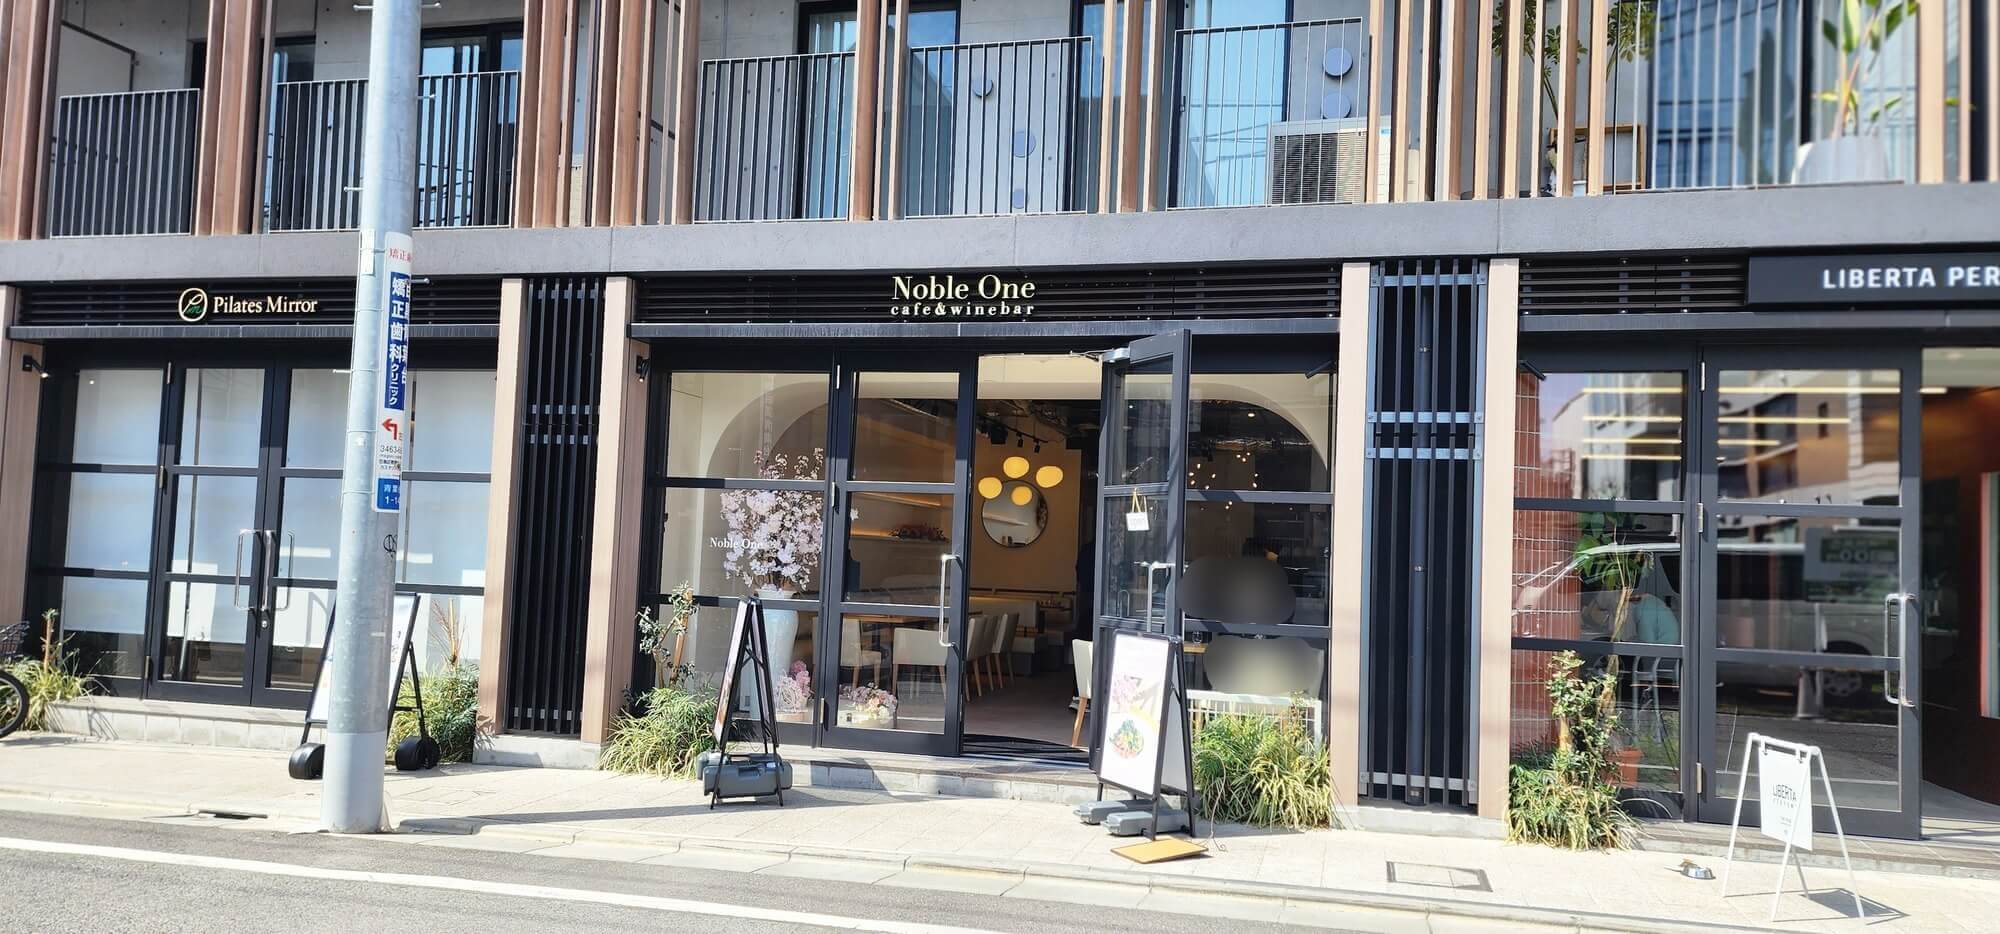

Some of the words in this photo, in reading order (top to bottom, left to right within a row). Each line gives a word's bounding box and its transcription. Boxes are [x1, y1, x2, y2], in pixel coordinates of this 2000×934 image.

[1822, 267, 1937, 289] LIBERTA
[1947, 266, 2000, 288] PER
[891, 275, 970, 300] Noble
[978, 274, 1036, 299] One
[213, 295, 263, 313] Pilates
[265, 295, 318, 313] Mirror
[890, 301, 1035, 316] cafe&winebar
[384, 496, 401, 505] 1-1
[710, 536, 739, 549] Noble
